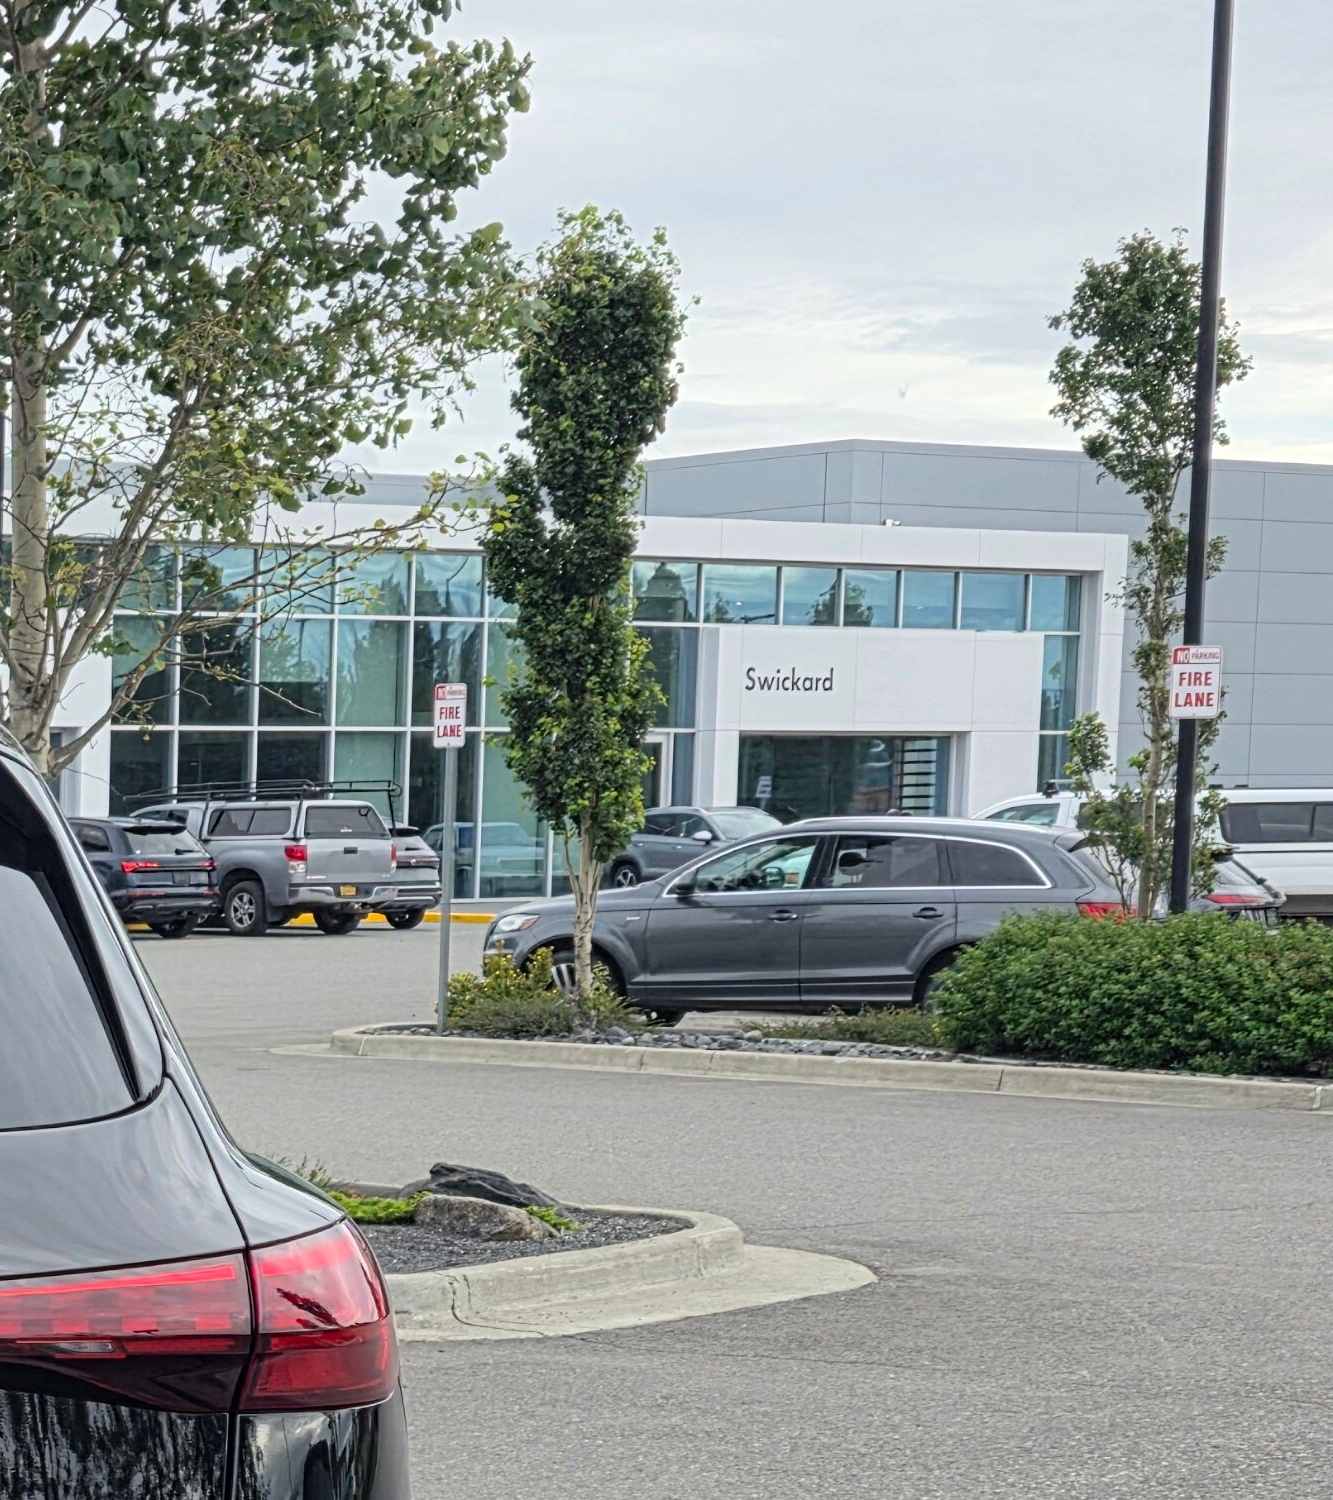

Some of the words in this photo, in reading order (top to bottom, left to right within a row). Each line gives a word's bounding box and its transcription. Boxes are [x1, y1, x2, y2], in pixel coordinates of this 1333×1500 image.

[1176, 649, 1190, 663] NO
[744, 666, 834, 692] Swickard
[1179, 671, 1213, 687] FIRE
[1174, 692, 1214, 708] LANE
[439, 706, 461, 720] FIRE
[436, 724, 462, 738] LANE
